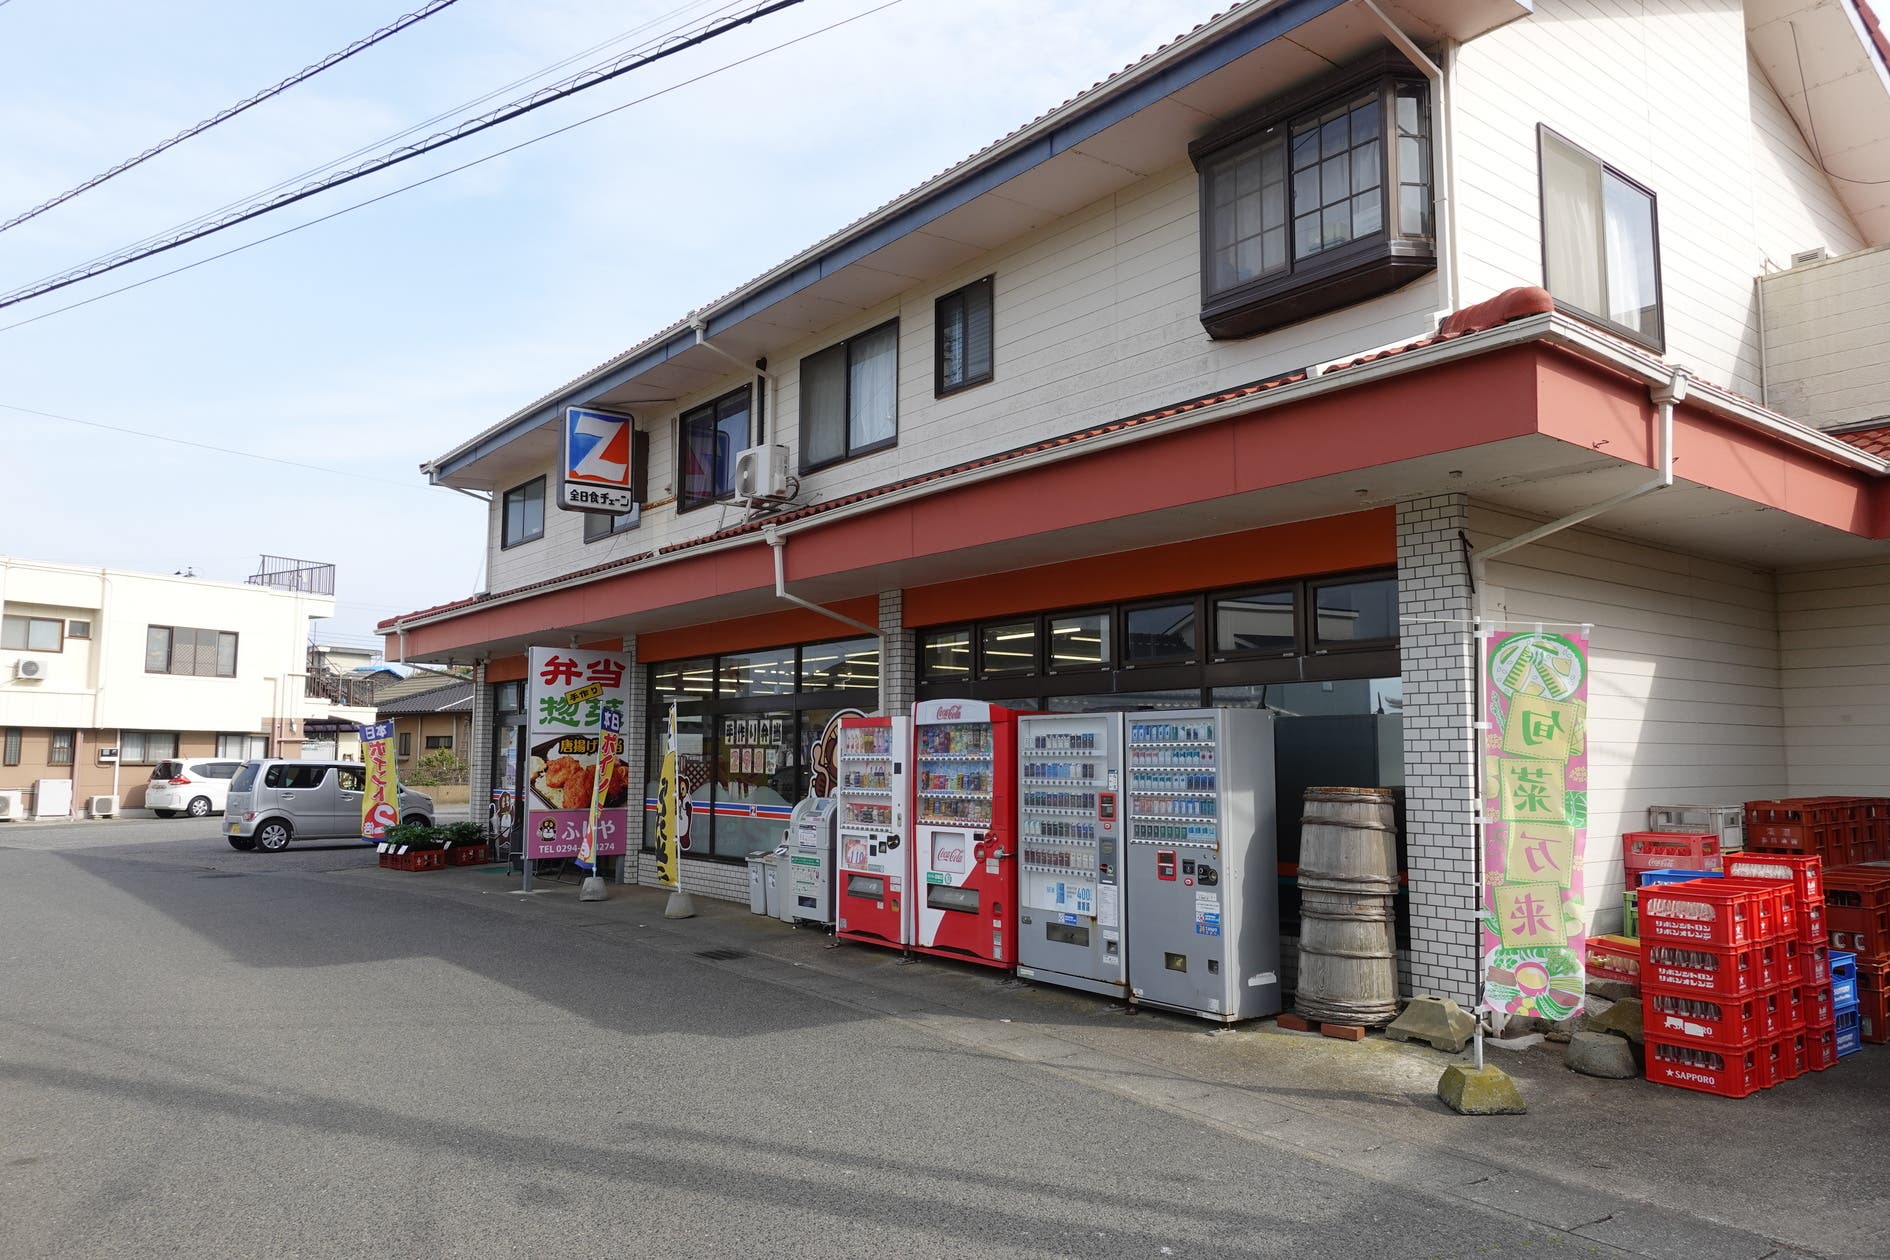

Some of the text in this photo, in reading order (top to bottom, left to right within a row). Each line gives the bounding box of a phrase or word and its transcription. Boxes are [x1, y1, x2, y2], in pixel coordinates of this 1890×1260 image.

[570, 488, 629, 507] 全日食チェーン
[540, 655, 626, 688] 弁当
[569, 686, 598, 702] 手作り
[726, 722, 782, 743] 手作り弁当
[539, 844, 554, 854] TEL
[1655, 920, 1711, 932] リボンシトロン
[1658, 967, 1714, 981] リボンシトロン
[1675, 1070, 1715, 1085] SAPPORO
